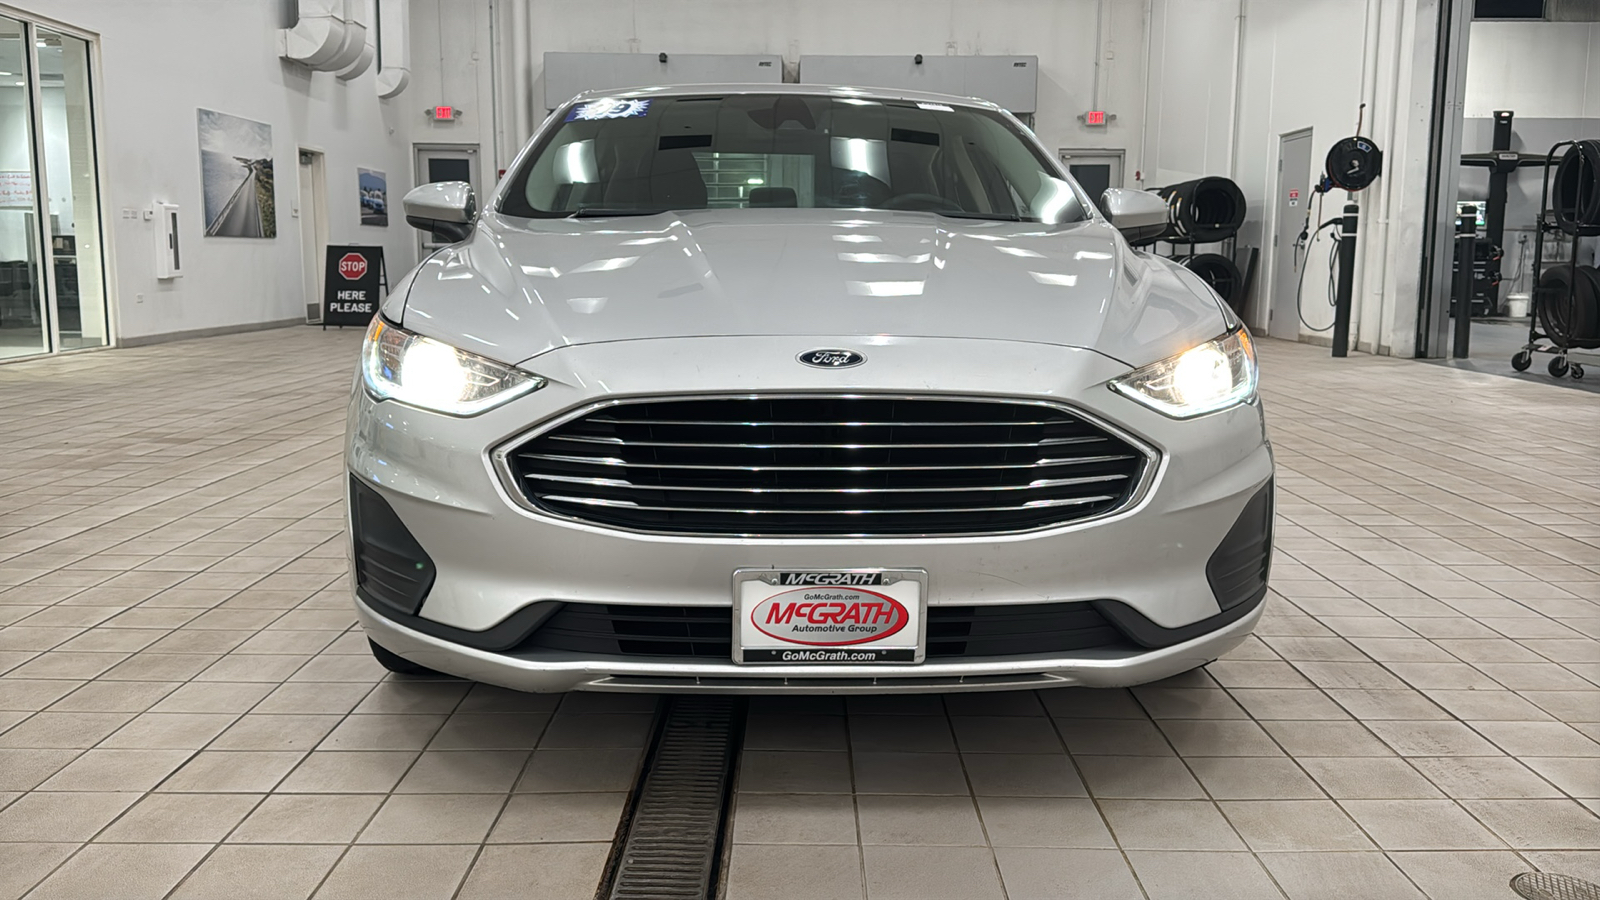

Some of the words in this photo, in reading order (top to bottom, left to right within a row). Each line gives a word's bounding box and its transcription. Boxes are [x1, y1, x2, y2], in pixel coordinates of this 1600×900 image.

[341, 261, 366, 272] STOP
[337, 290, 366, 300] HERE
[329, 302, 372, 313] PLEASE
[811, 351, 852, 364] Ford
[803, 593, 860, 601] GoMcGrath.com
[791, 624, 846, 633] Automotive
[847, 624, 878, 634] Group
[782, 651, 876, 661] GoMcGrath.com
